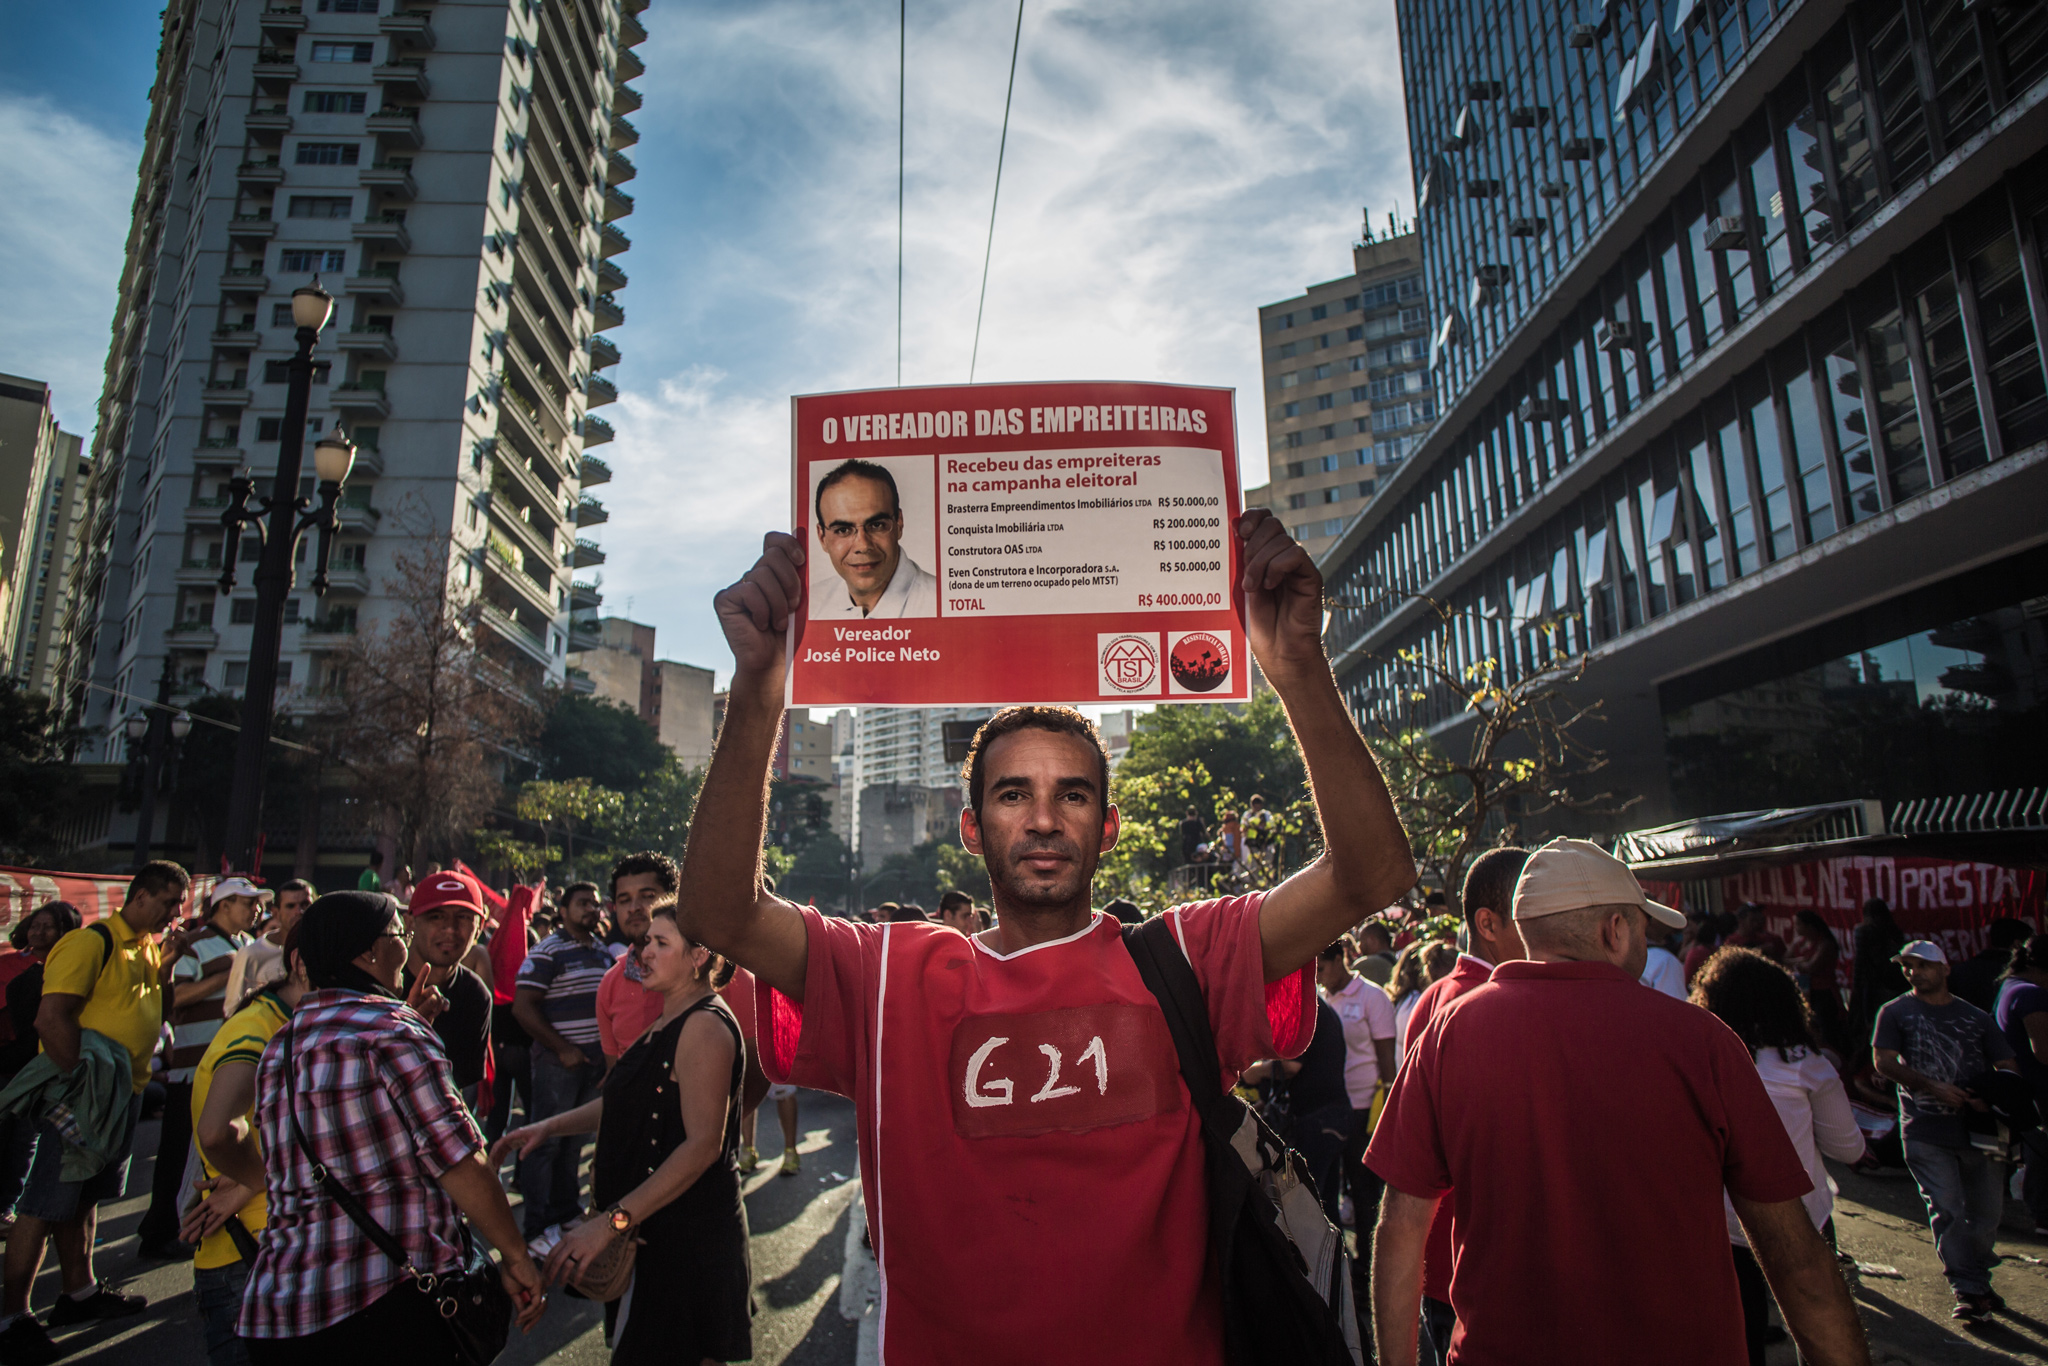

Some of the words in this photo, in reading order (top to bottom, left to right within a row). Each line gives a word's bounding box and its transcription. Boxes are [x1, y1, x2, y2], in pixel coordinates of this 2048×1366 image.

[823, 417, 838, 444] O
[843, 410, 968, 442] VEREADOR
[974, 408, 1024, 436] DAS
[1030, 405, 1208, 434] EMPREITEIRAS
[947, 457, 1019, 474] Recebeu
[1023, 456, 1053, 470] das
[1057, 453, 1161, 471] empreiteras
[947, 481, 968, 493] na
[972, 474, 1061, 494] campanha
[1065, 471, 1137, 488] eleitoral
[947, 504, 989, 514] Brasterra
[991, 500, 1076, 514] Empreendimentos
[1077, 497, 1133, 509] Imobiliários
[1135, 499, 1152, 507] LTDA
[1158, 497, 1170, 508] R$
[1172, 497, 1219, 508] 50.000,00
[947, 524, 994, 536] Conquista
[995, 522, 1046, 534] Imobiliária
[1047, 524, 1064, 532] LTDA
[1153, 518, 1165, 529] R$
[1167, 518, 1220, 529] 200.000,00
[948, 546, 1002, 556] Construtora
[1004, 544, 1024, 554] OAS
[1025, 546, 1043, 554] LTDA
[1153, 540, 1166, 551] R$
[1168, 539, 1221, 550] 100.000,00
[948, 568, 970, 577] Even
[972, 565, 1027, 577] Construtora
[1029, 567, 1035, 575] e
[1036, 563, 1103, 576] Incorporadora
[1160, 562, 1172, 573] R$
[1174, 561, 1221, 572] 50.000,00
[948, 580, 972, 591] (dona
[974, 579, 985, 589] de
[986, 581, 999, 589] um
[1001, 579, 1032, 588] terreno
[1034, 577, 1070, 589] ocupado
[1071, 576, 1091, 589] pelo
[1092, 576, 1119, 586] MTST)
[949, 599, 985, 611] TOTAL
[1138, 593, 1153, 607] R$
[1155, 593, 1221, 607] 400.000,00
[834, 626, 911, 641] Vereador
[804, 648, 841, 662] José
[845, 647, 896, 662] Police
[900, 647, 941, 661] Neto
[1818, 856, 1897, 910] NETO
[1901, 863, 2021, 910] PRESTA
[964, 1036, 1014, 1108] G
[1031, 1036, 1108, 1103] 21
